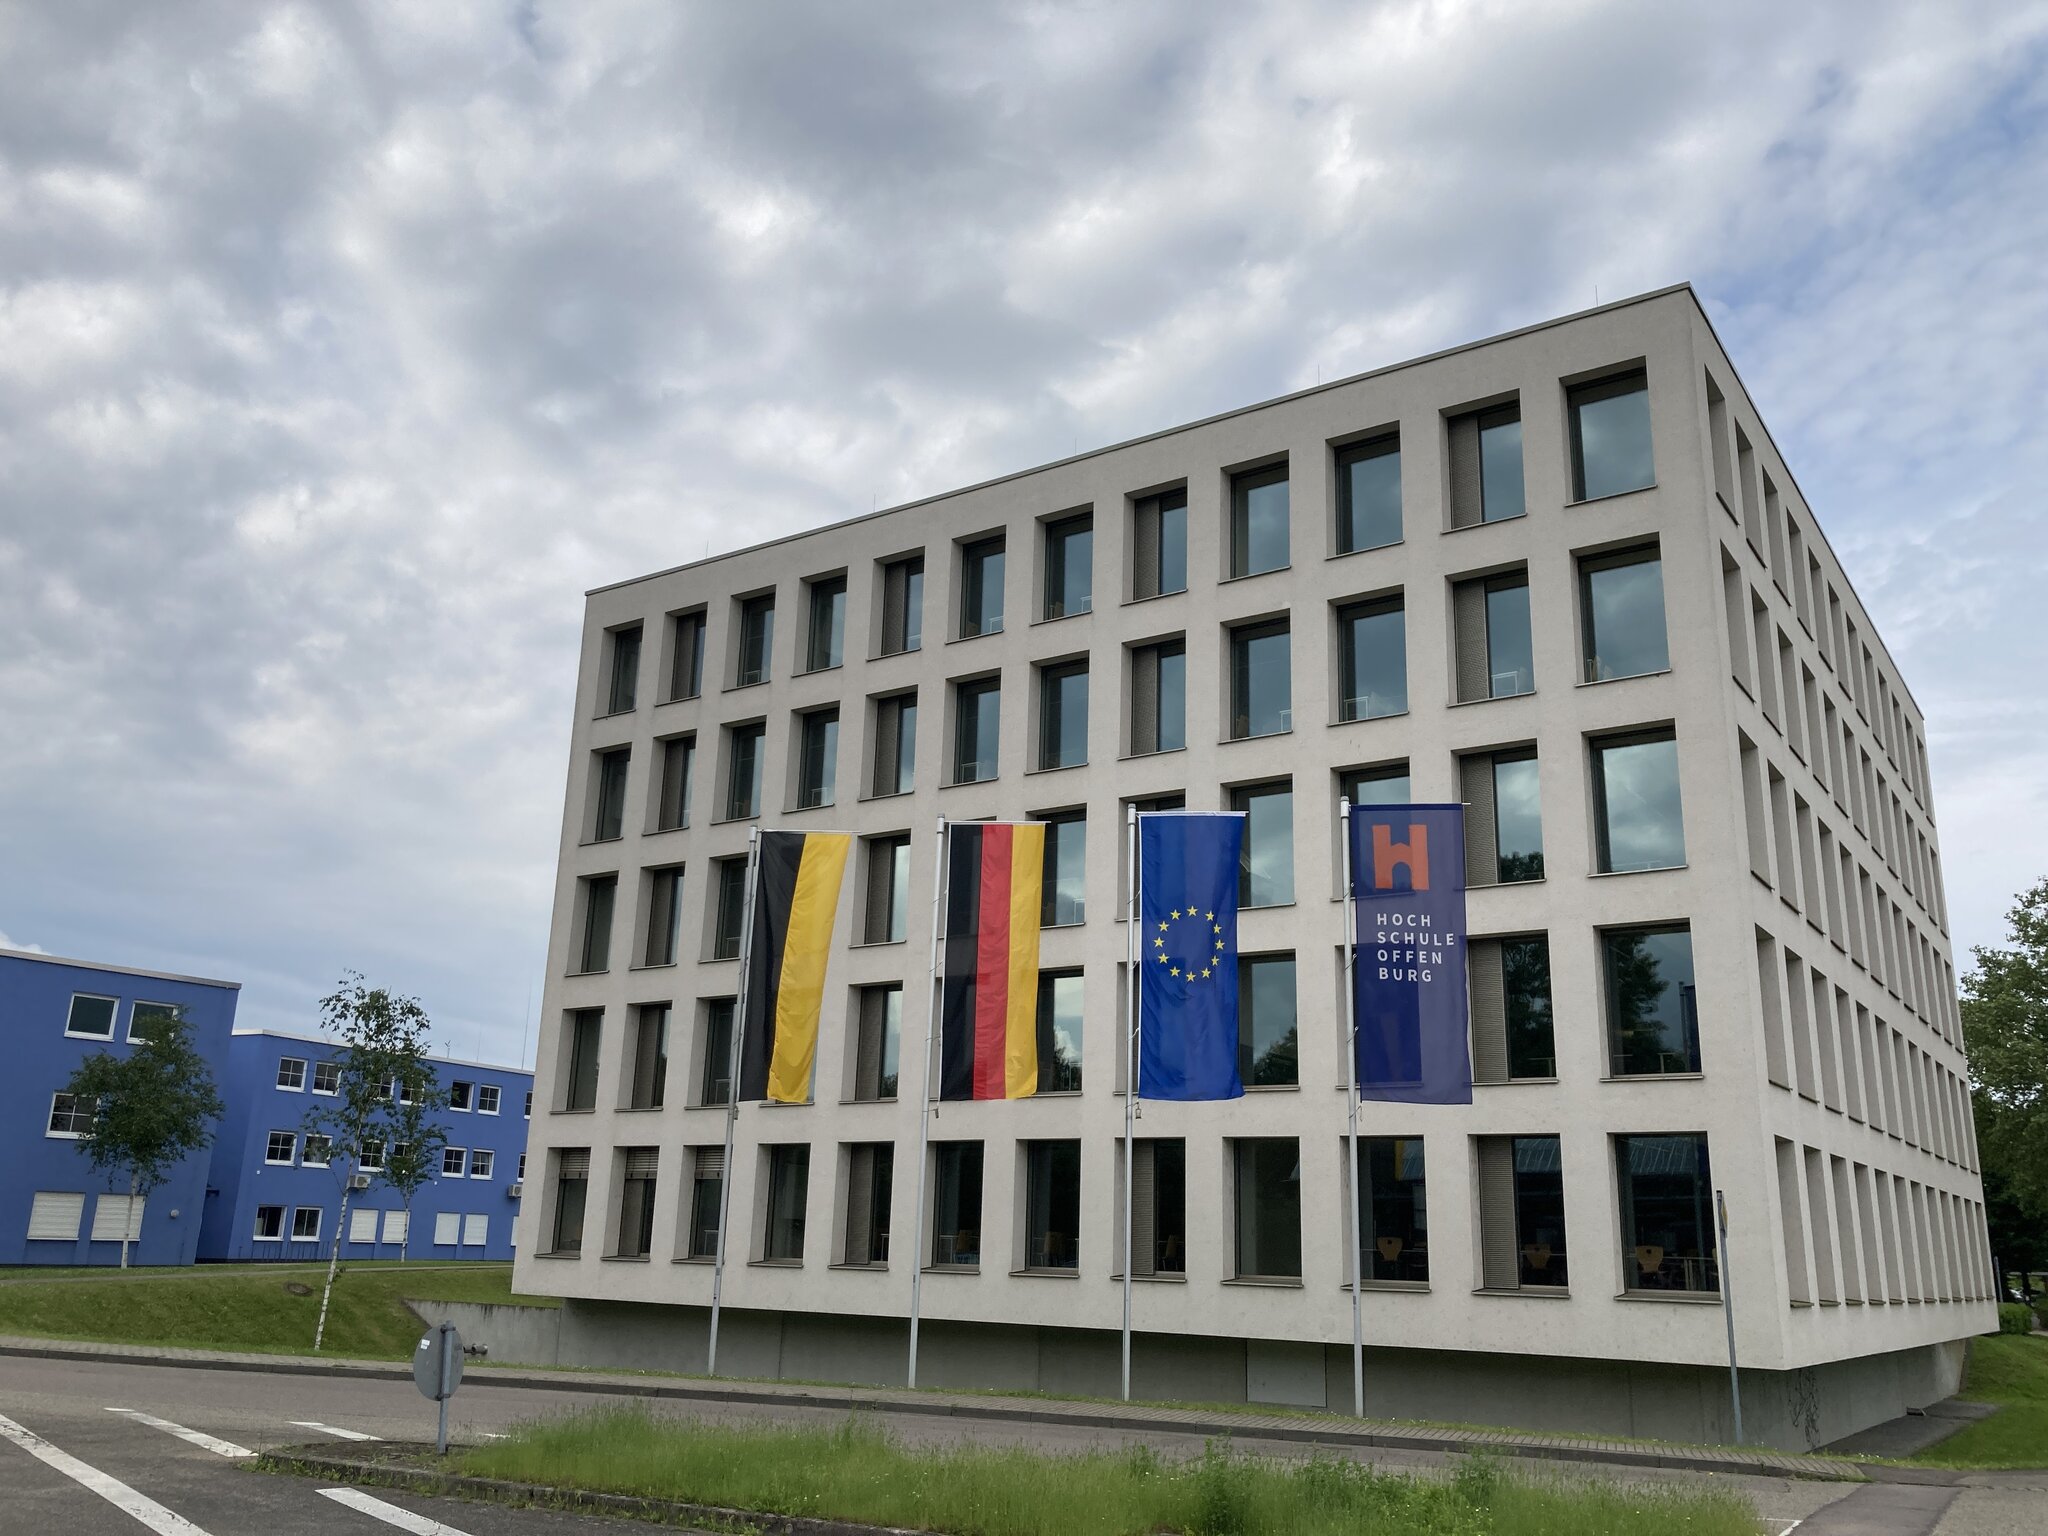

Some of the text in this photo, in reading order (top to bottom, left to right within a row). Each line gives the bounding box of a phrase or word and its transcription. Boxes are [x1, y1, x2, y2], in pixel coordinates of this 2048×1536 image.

[1376, 913, 1431, 927] HOCH
[1376, 931, 1455, 946] SCHULE
[1377, 949, 1442, 964] OFFEN
[1379, 967, 1432, 982] BURG
